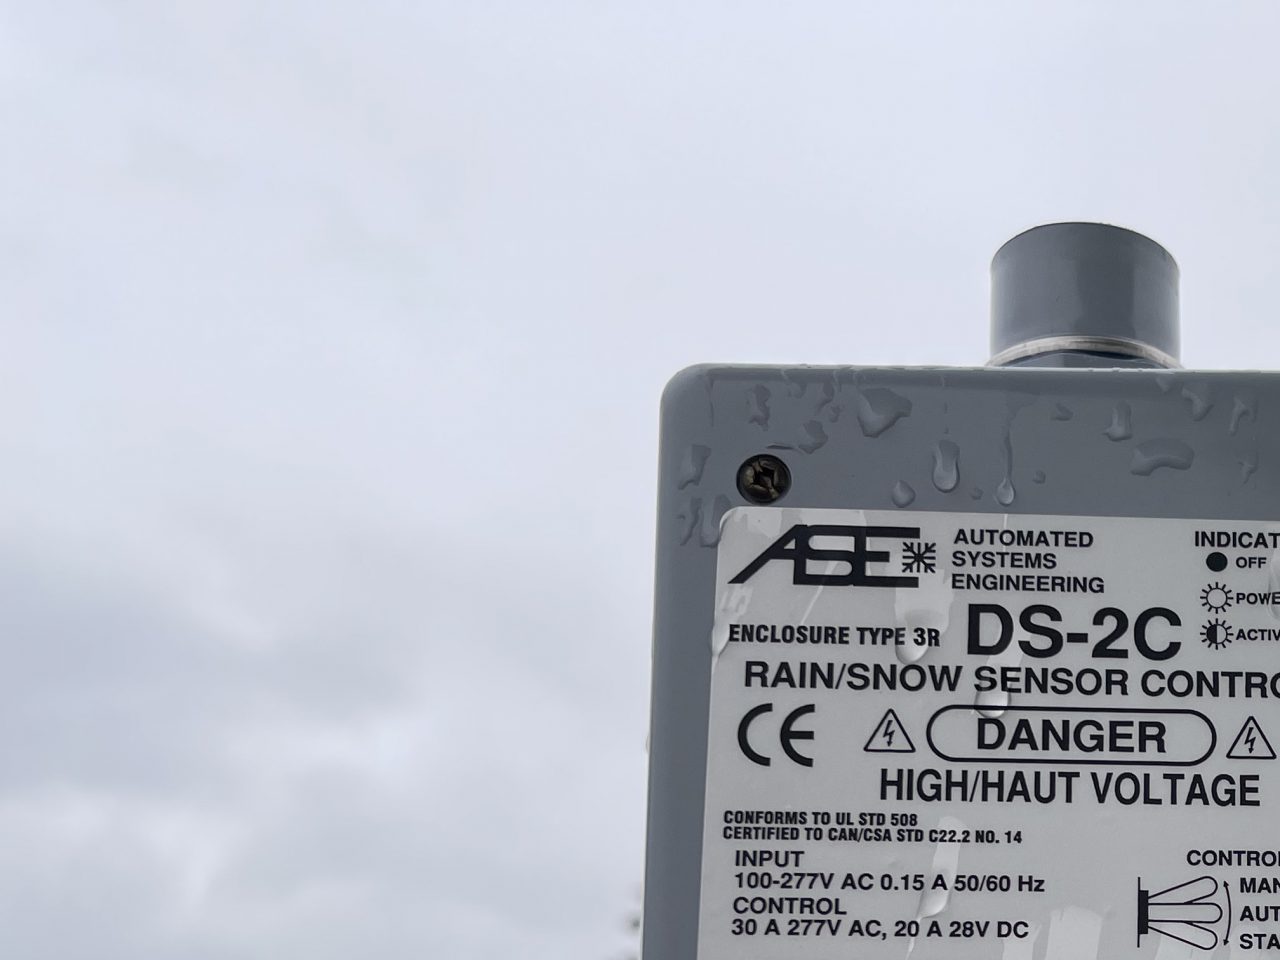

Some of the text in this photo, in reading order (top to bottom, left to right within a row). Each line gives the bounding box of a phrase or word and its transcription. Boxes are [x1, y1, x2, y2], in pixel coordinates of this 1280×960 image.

[954, 529, 1093, 547] AUTOMATED
[952, 551, 1056, 569] SYSTEMS
[1236, 557, 1267, 568] OFF
[952, 573, 1104, 593] ENGINEERING
[728, 624, 940, 647] ENCLOSURE TYPE 3R
[967, 604, 1181, 661] DS-2C
[745, 661, 963, 691] RAIN/SNOW
[974, 666, 1128, 696] SENSOR
[738, 703, 815, 767] CE
[977, 717, 1166, 753] DANGER
[880, 768, 1260, 806] HIGH/HAUT VOLTAGE
[724, 811, 917, 826] CONFORMS TO UL STD 508
[723, 826, 1022, 843] CERTIFIED TO CAN/CSA STD C22.2 NO. 14
[736, 850, 804, 867] INPUT
[735, 872, 1044, 892] 100-277V AC 0.15 A 50/60 Hz
[733, 897, 847, 915] CONTROL
[732, 919, 1028, 940] 30 A 277V AC, 20 A 28V DC
